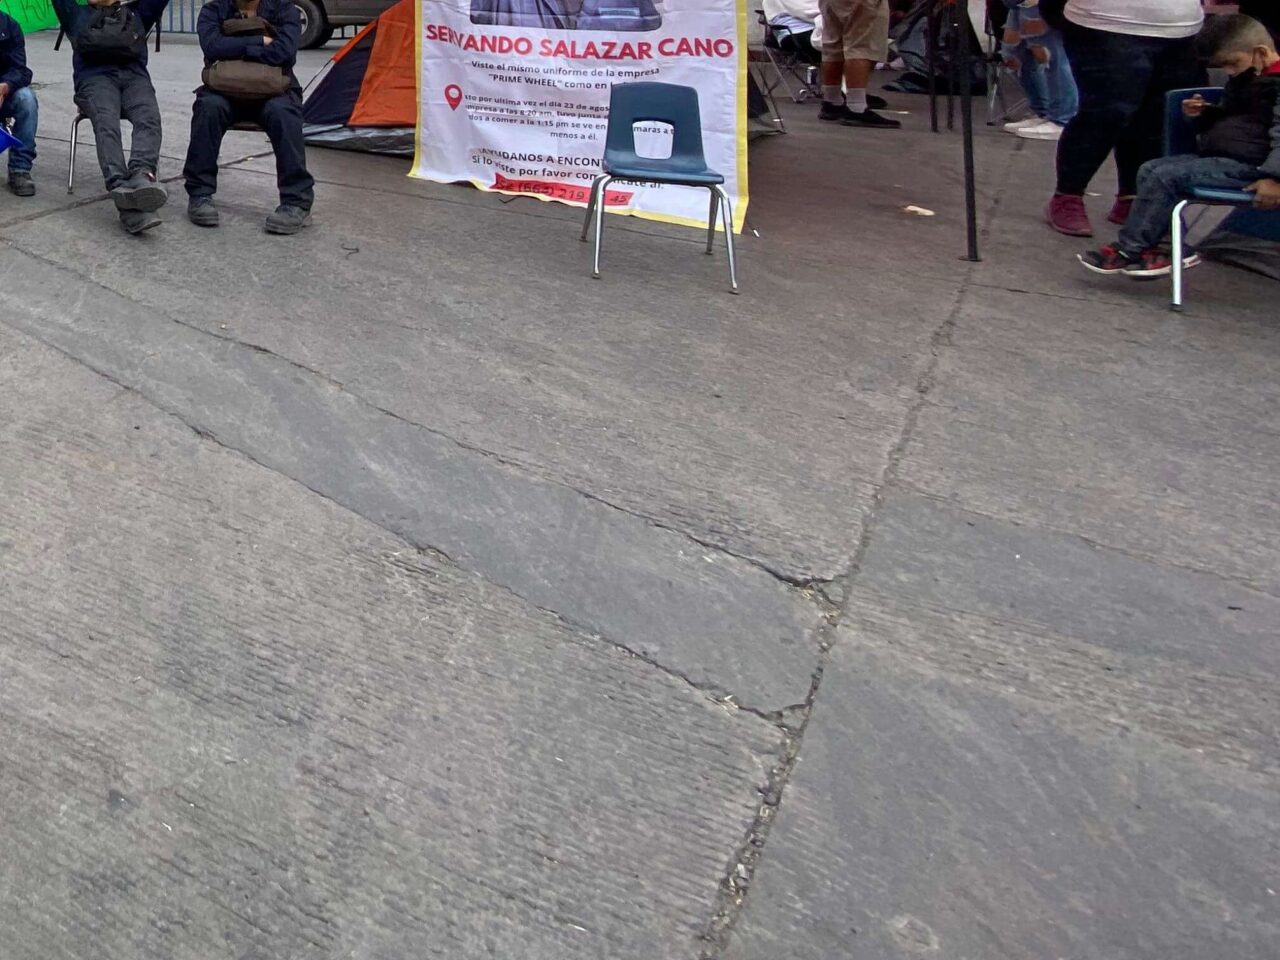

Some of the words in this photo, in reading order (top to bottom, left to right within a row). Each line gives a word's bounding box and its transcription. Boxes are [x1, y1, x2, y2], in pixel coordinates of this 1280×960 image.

[426, 24, 533, 55] SERVANDO
[539, 38, 653, 60] SALAZAR
[658, 37, 734, 58] CANO
[471, 60, 494, 70] Viste
[496, 63, 506, 71] el
[508, 64, 541, 74] mismo
[543, 67, 588, 77] uniforme
[591, 68, 605, 77] de
[606, 68, 616, 77] la
[618, 68, 660, 79] empresa
[565, 81, 592, 89] como
[465, 105, 498, 113] mpresa
[576, 102, 587, 110] de
[589, 105, 610, 113] agos
[468, 113, 483, 121] dos
[491, 116, 518, 124] comer
[556, 121, 569, 129] pm
[633, 125, 661, 134] maras
[550, 131, 578, 139] menos
[472, 155, 480, 164] Si
[483, 156, 493, 165] lo
[519, 168, 539, 177] por
[542, 168, 572, 178] favor
[546, 155, 555, 164] A
[558, 156, 604, 167] ENCON
